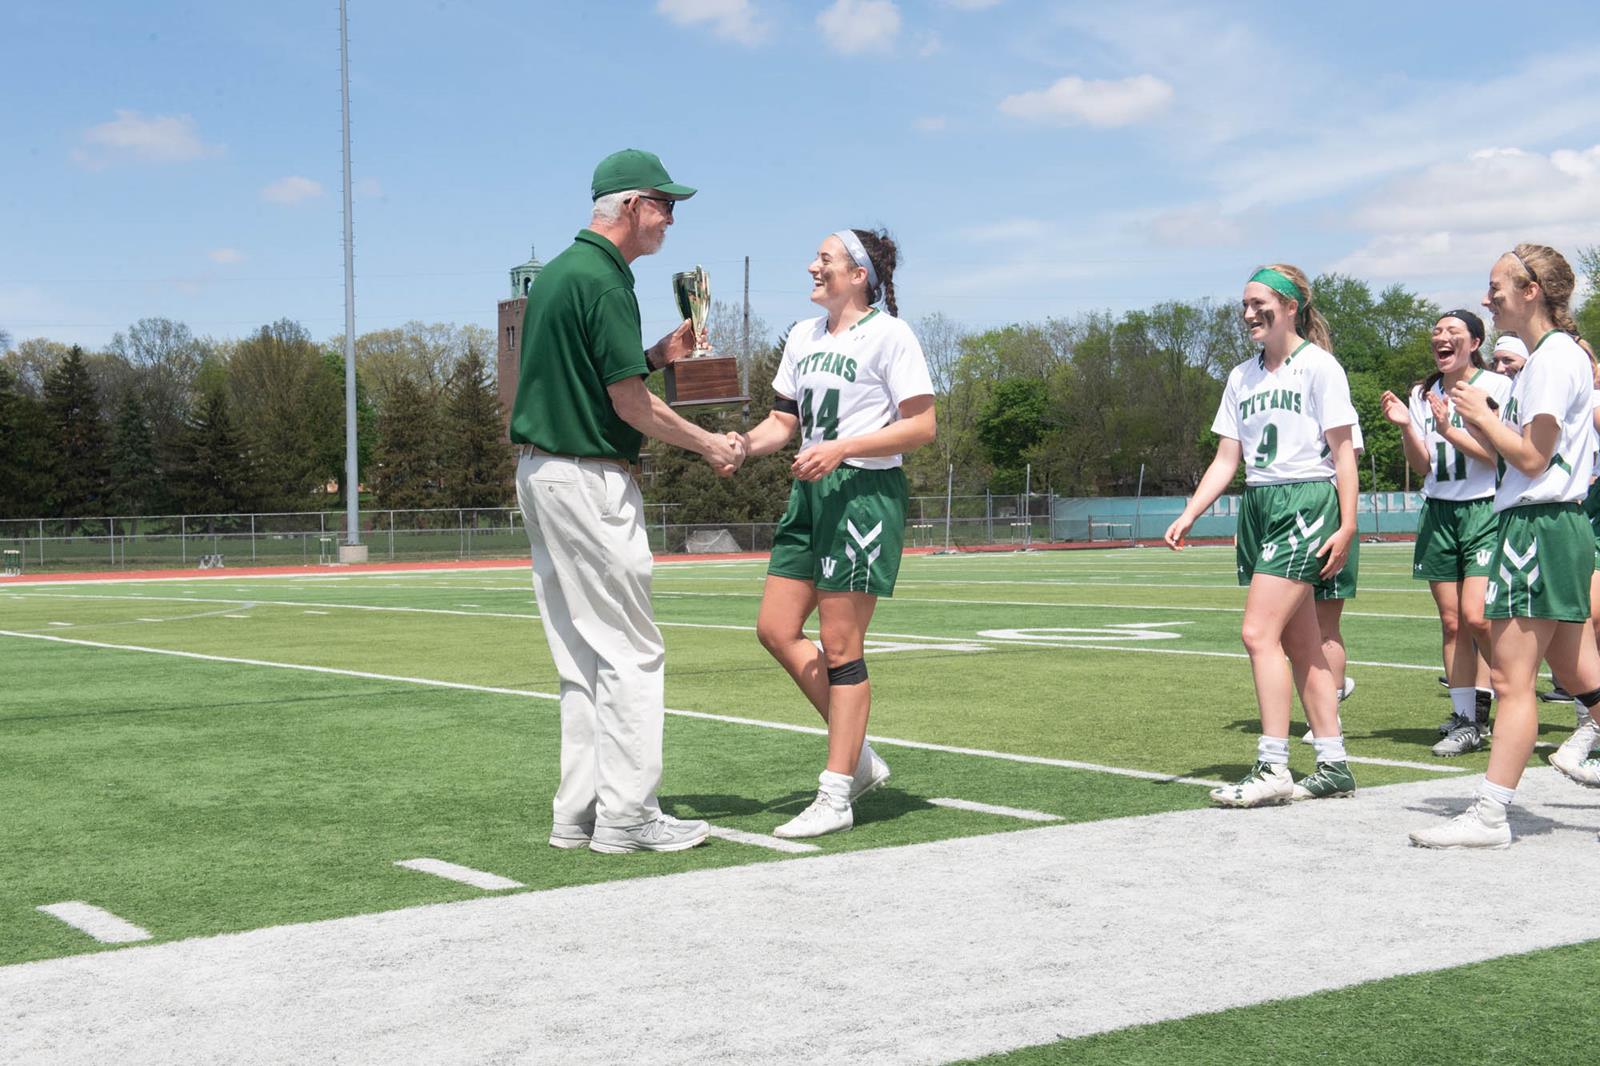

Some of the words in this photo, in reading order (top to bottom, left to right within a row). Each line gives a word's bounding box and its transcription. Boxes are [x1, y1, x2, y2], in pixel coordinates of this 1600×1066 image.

[797, 351, 858, 383] TITANS
[801, 388, 840, 440] 44
[1239, 388, 1302, 421] TITANS
[1254, 422, 1278, 469] 9
[1436, 442, 1468, 482] 11
